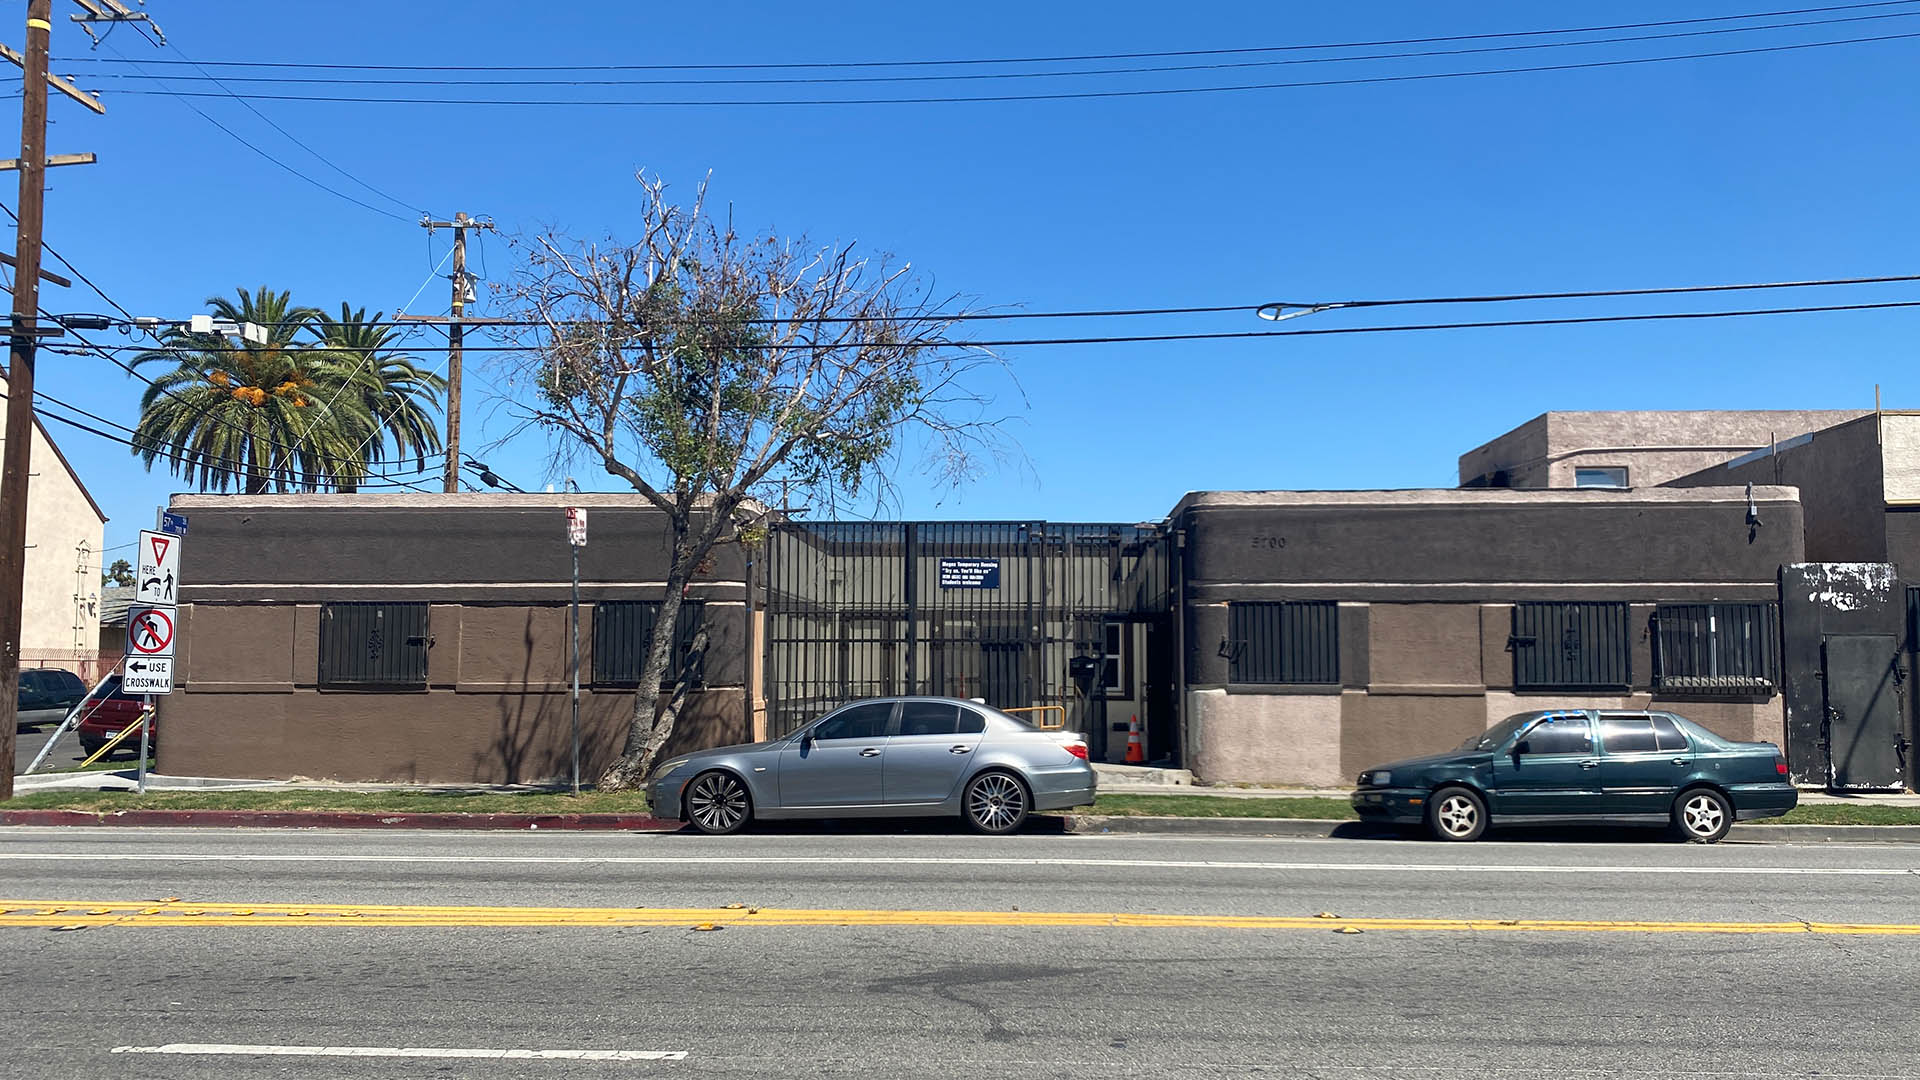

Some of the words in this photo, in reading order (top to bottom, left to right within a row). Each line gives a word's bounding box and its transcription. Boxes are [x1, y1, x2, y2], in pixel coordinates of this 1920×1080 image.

[142, 564, 156, 576] HERE
[154, 586, 160, 597] TO
[149, 662, 167, 673] USE
[125, 677, 170, 688] CROSSWALK
